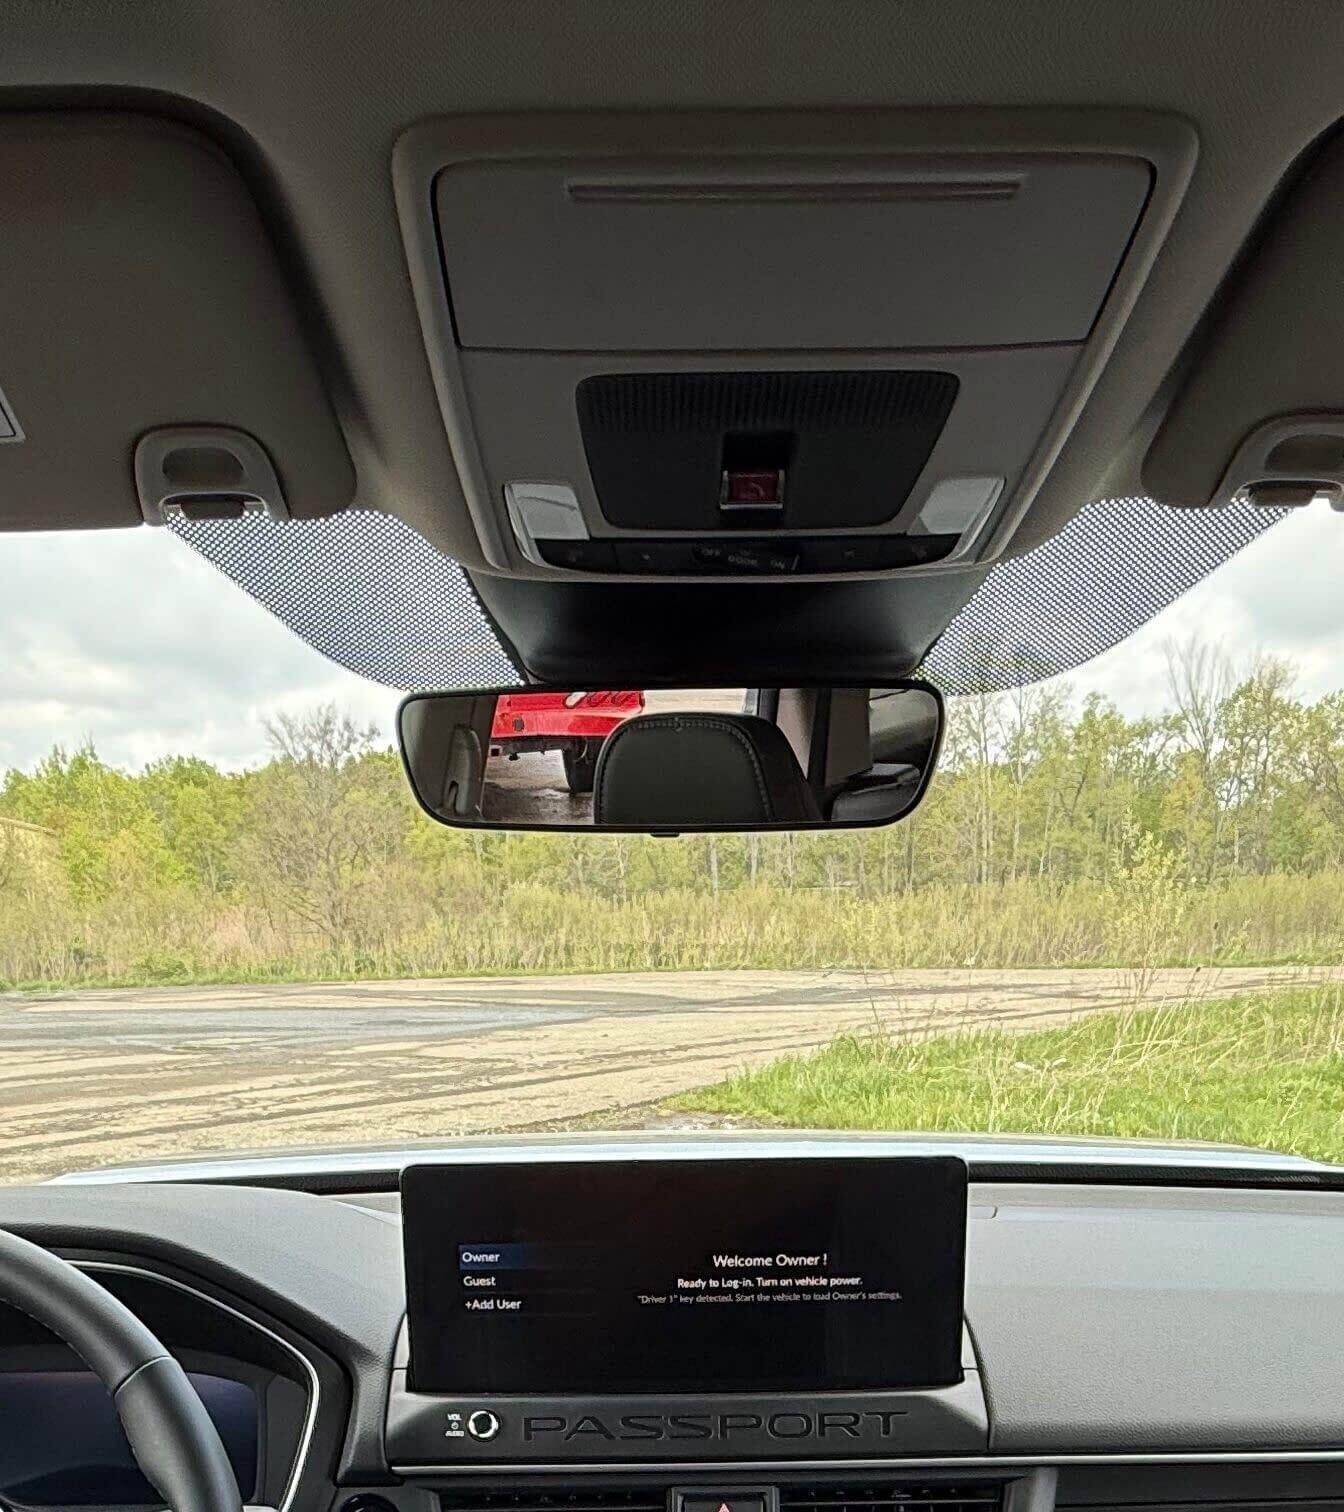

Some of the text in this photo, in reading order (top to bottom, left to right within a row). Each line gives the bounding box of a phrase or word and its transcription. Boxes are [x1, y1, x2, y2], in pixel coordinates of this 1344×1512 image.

[462, 1251, 500, 1263] Owner
[713, 1254, 772, 1267] Welcome
[775, 1254, 820, 1267] Owner
[463, 1275, 496, 1287] Guest
[677, 1276, 863, 1290] Ready to Log-in. Turn on vehicle power.
[464, 1298, 522, 1311] +Add User
[523, 1411, 909, 1443] PASSPORT
